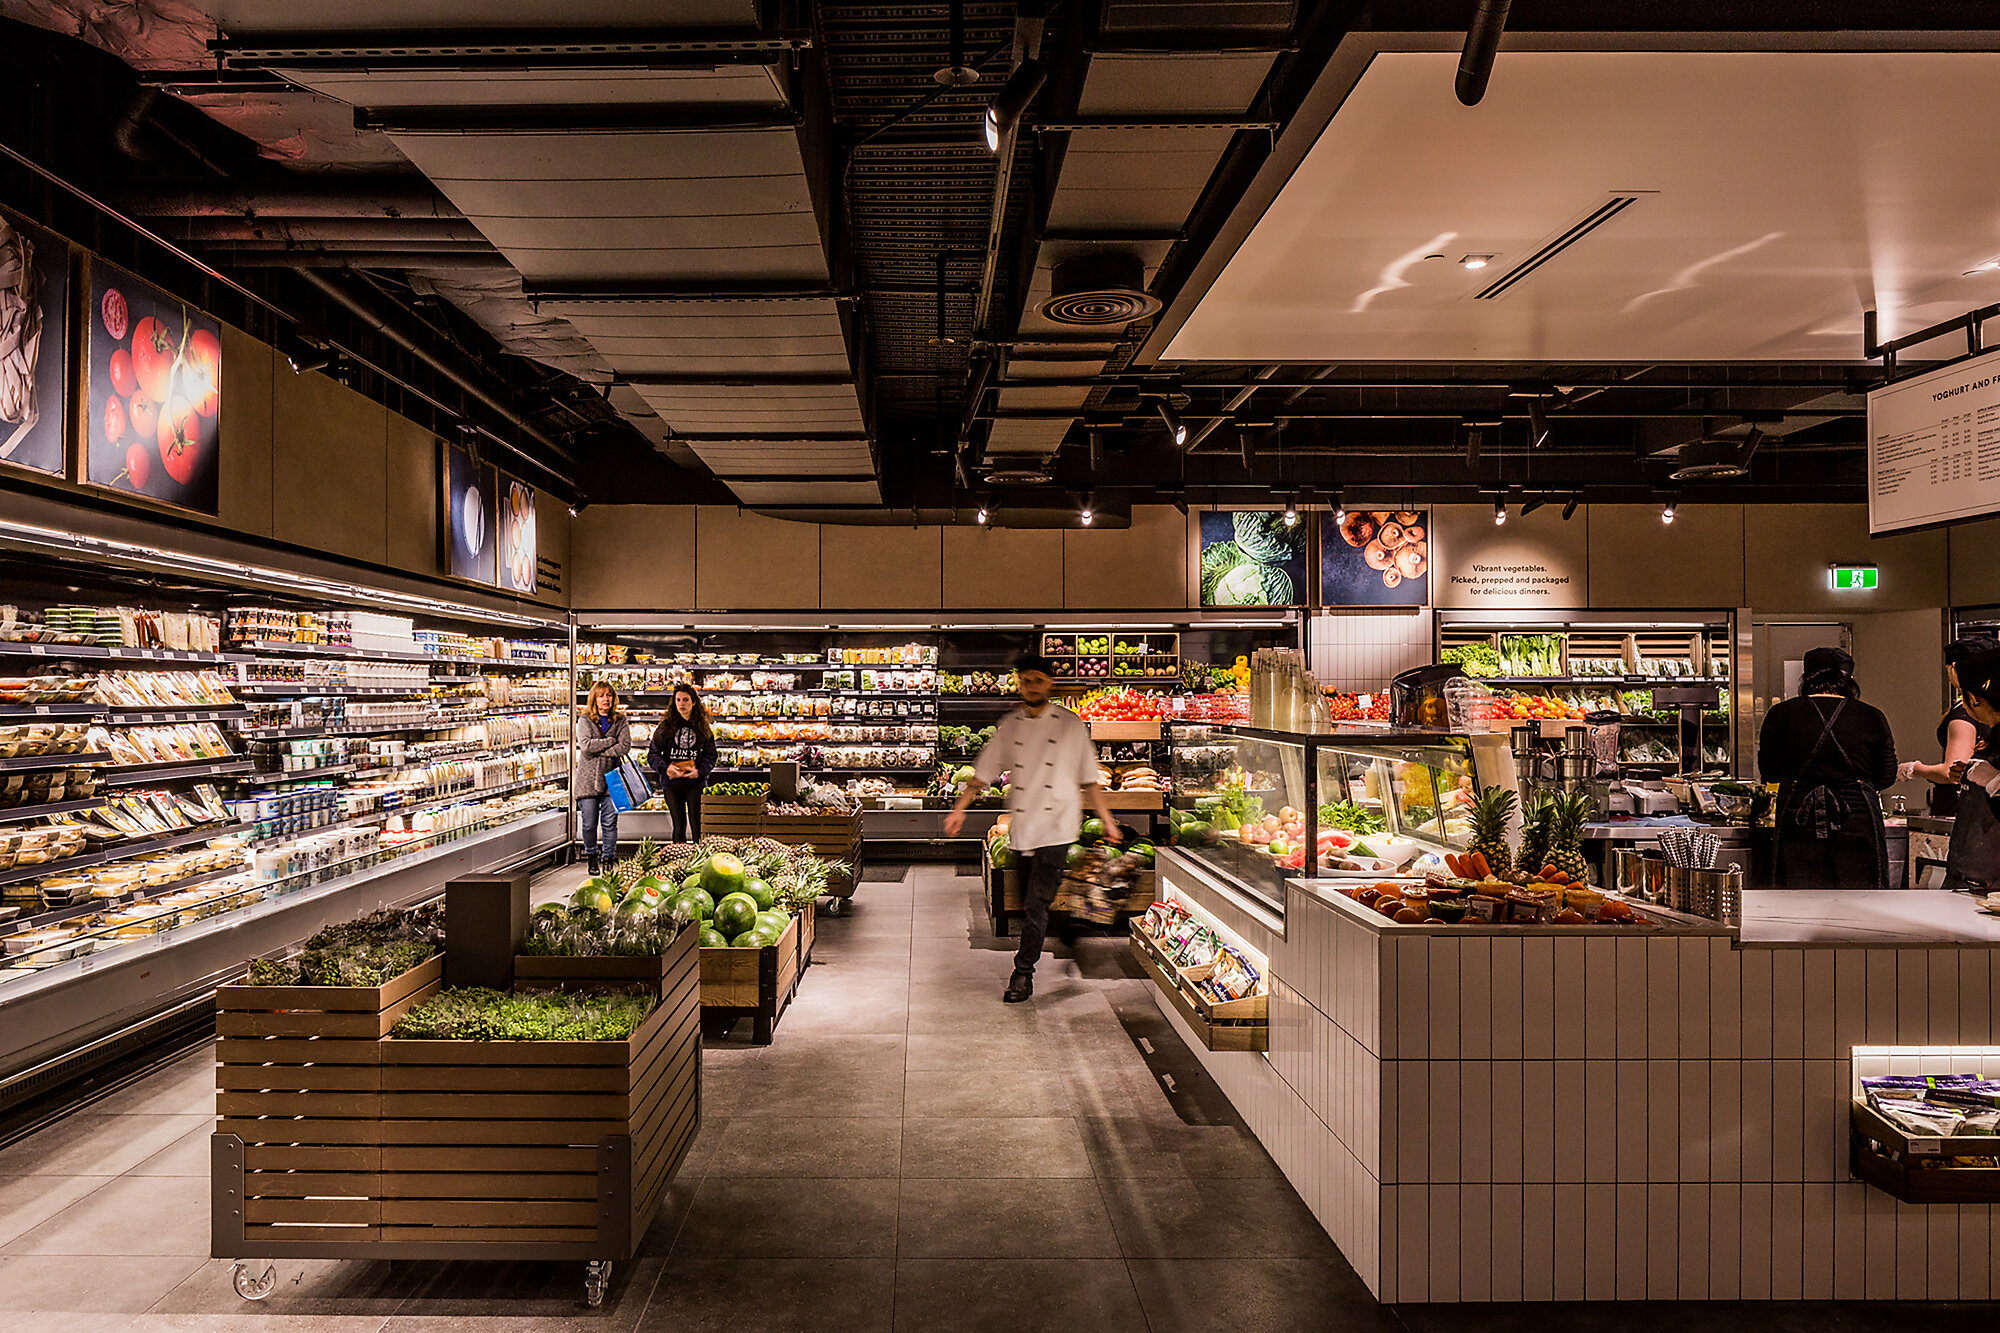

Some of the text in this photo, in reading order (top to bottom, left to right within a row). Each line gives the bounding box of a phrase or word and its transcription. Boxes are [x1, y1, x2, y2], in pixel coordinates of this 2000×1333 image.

[1932, 384, 1970, 401] YOGHURT
[1972, 379, 1990, 390] AND
[1472, 564, 1548, 574] Vibrant vegetables.
[1451, 575, 1570, 585] Picked, prepped and packaged
[1470, 587, 1482, 595] for
[1483, 587, 1518, 595] delicious
